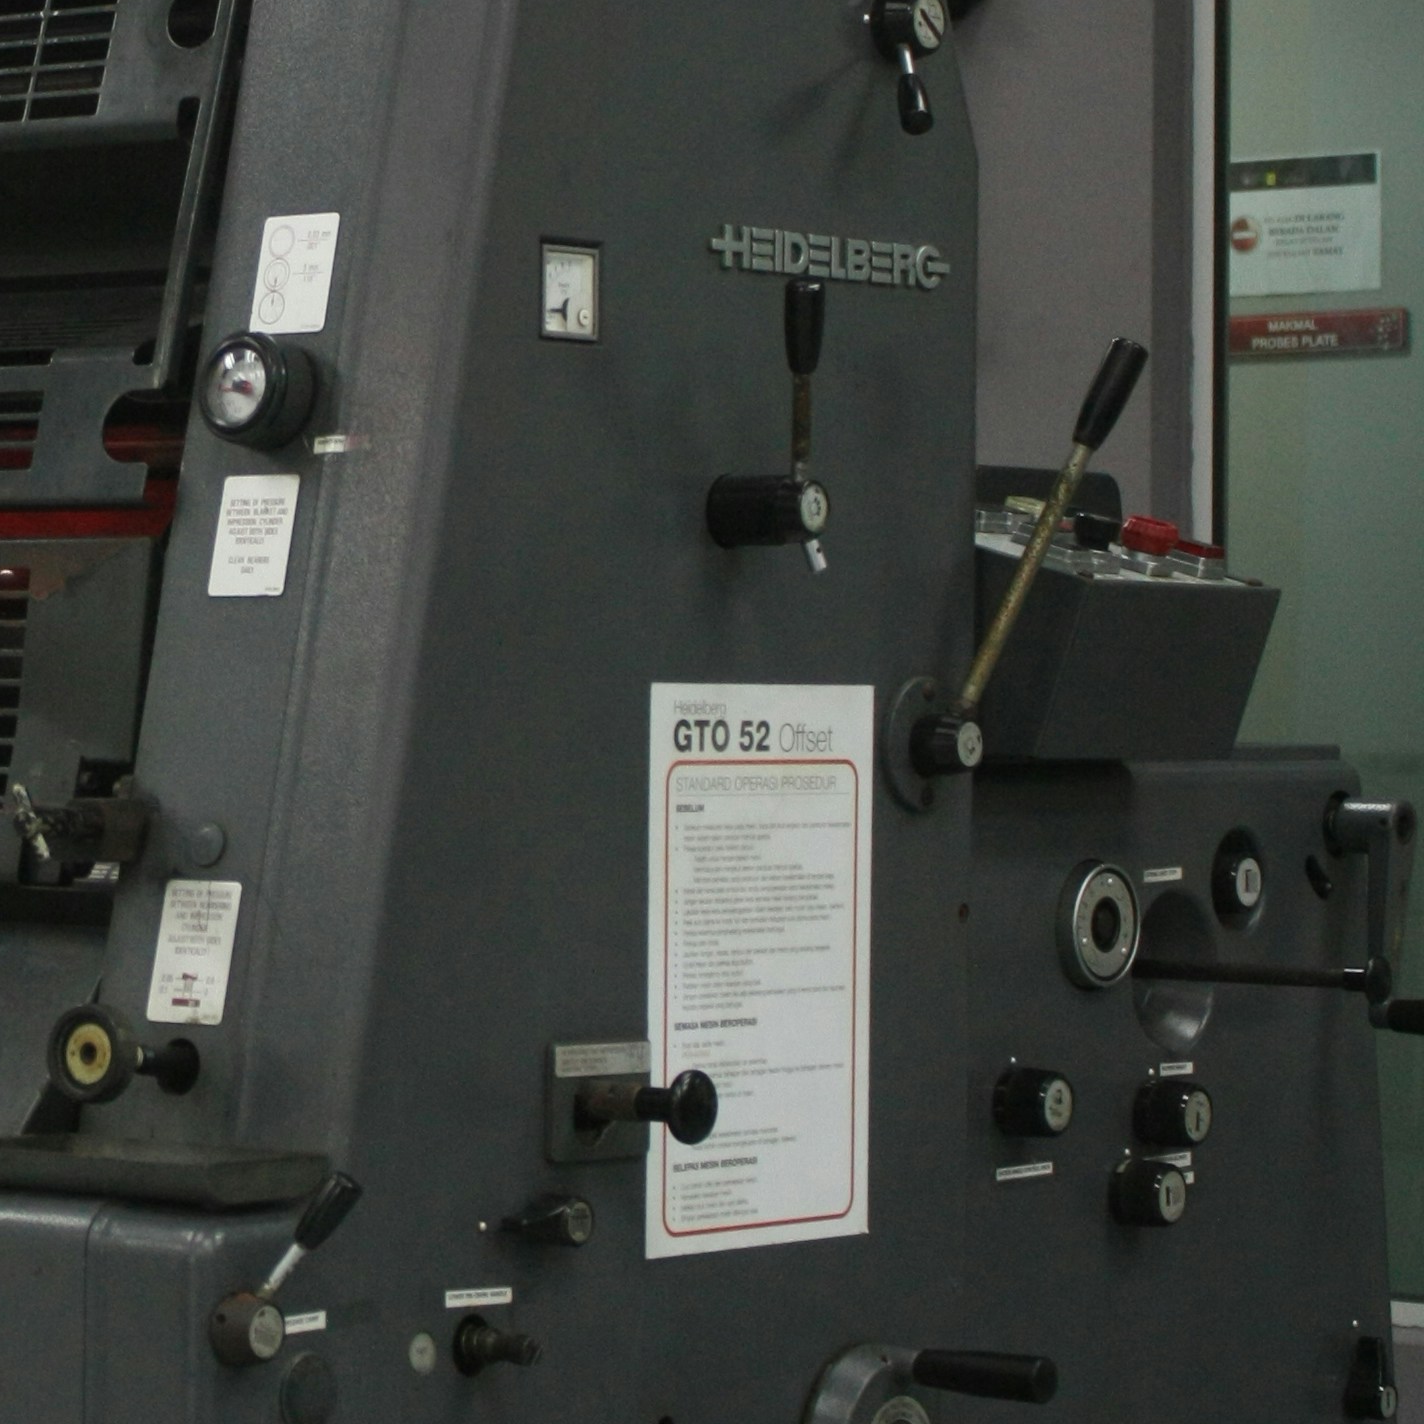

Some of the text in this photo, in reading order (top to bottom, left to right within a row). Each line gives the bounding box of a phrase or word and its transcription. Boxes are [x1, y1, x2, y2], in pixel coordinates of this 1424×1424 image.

[711, 224, 951, 289] HEIDELBERG
[1267, 319, 1317, 332] MAKMAL
[1302, 332, 1339, 348] PLATE
[673, 719, 833, 752] GTO 52 Offset
[676, 775, 837, 792] STANDARD OPERASI PROSEDUR
